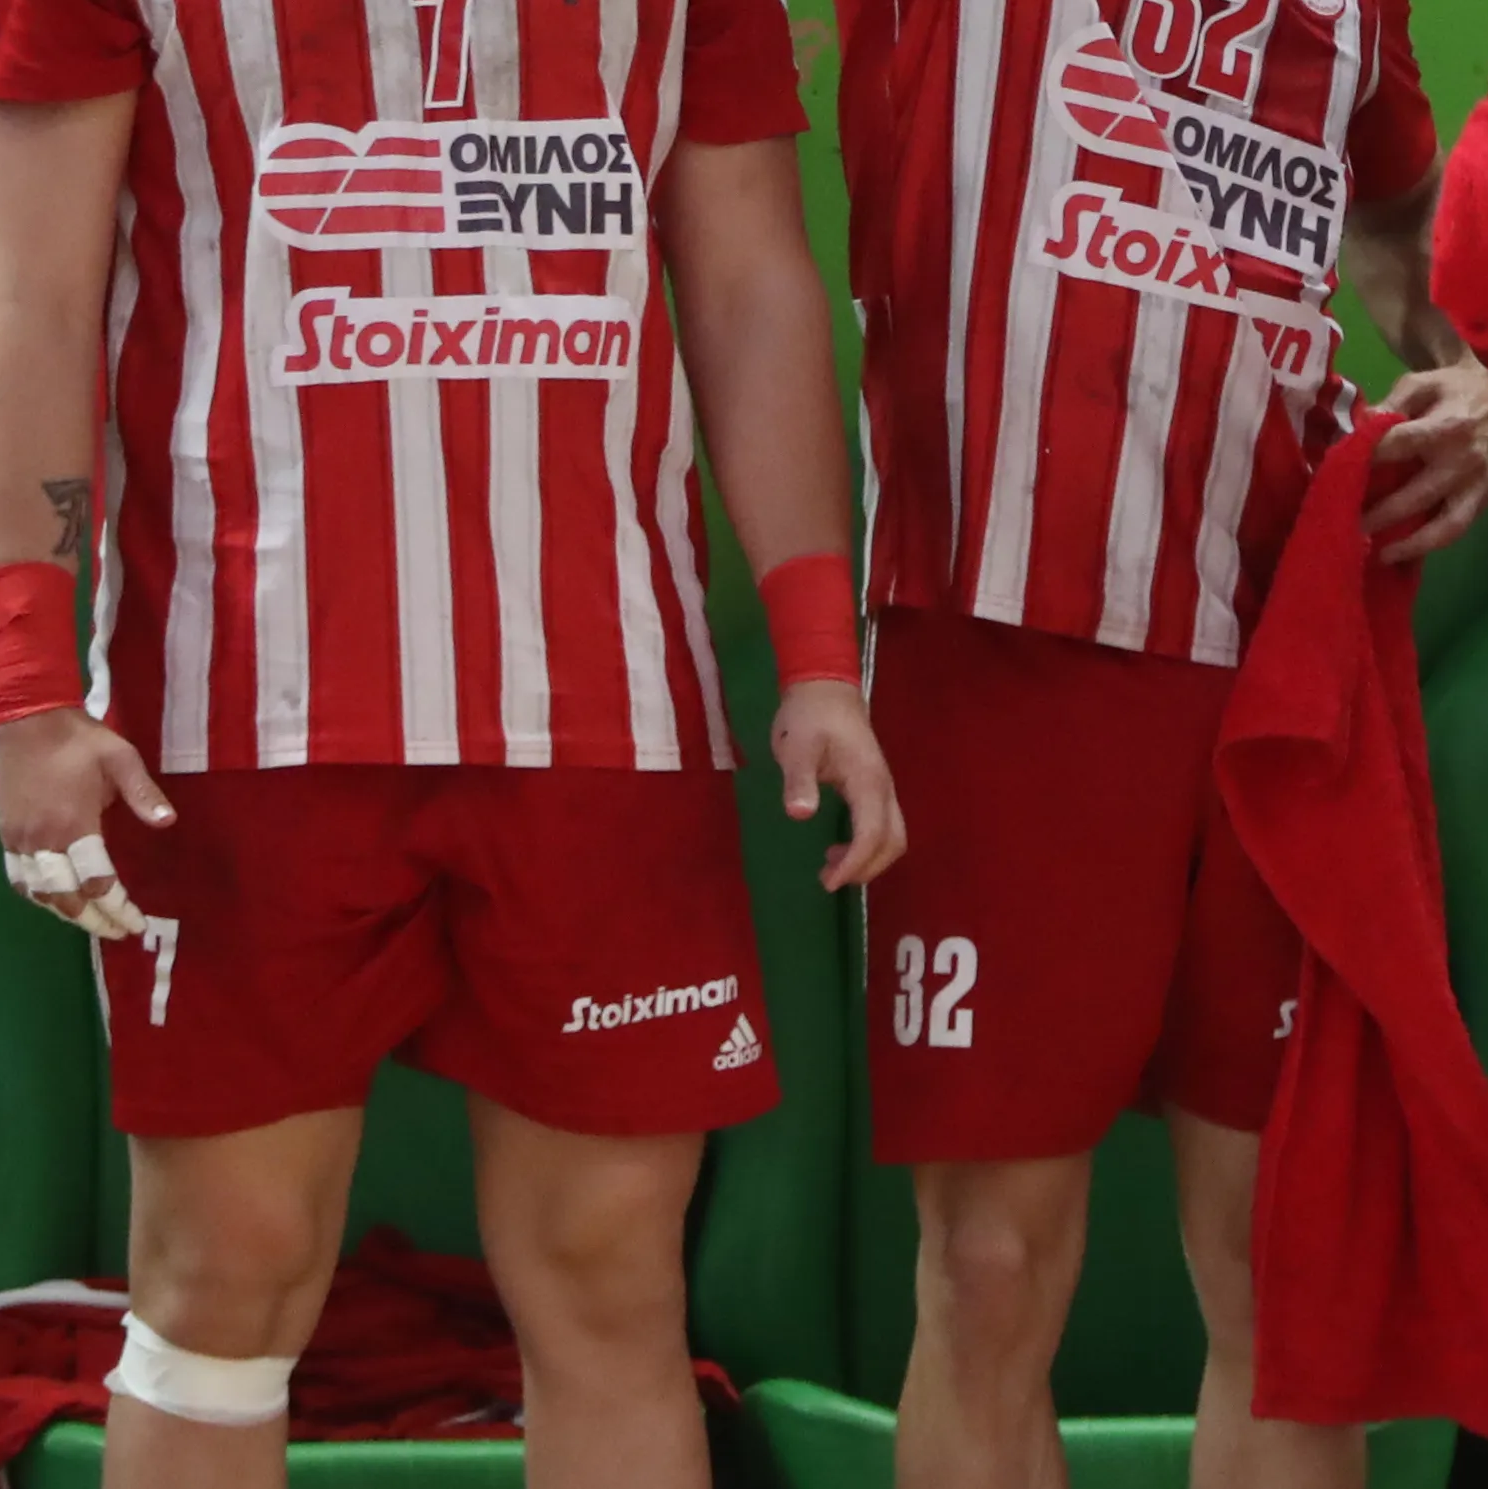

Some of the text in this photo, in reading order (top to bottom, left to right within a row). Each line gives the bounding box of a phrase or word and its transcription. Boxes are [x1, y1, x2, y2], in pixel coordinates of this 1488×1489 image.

[449, 133, 632, 174] ΟΜΙΛΟΣ
[1173, 116, 1339, 210] ΟΜΙΛΟΣ
[455, 180, 633, 235] ΞΥΝΗ
[1043, 193, 1311, 376] Stoixn
[284, 299, 632, 372] Stoiximan
[143, 915, 179, 1026] 7
[562, 974, 739, 1034] Stoiximan
[893, 934, 978, 1049] 32
